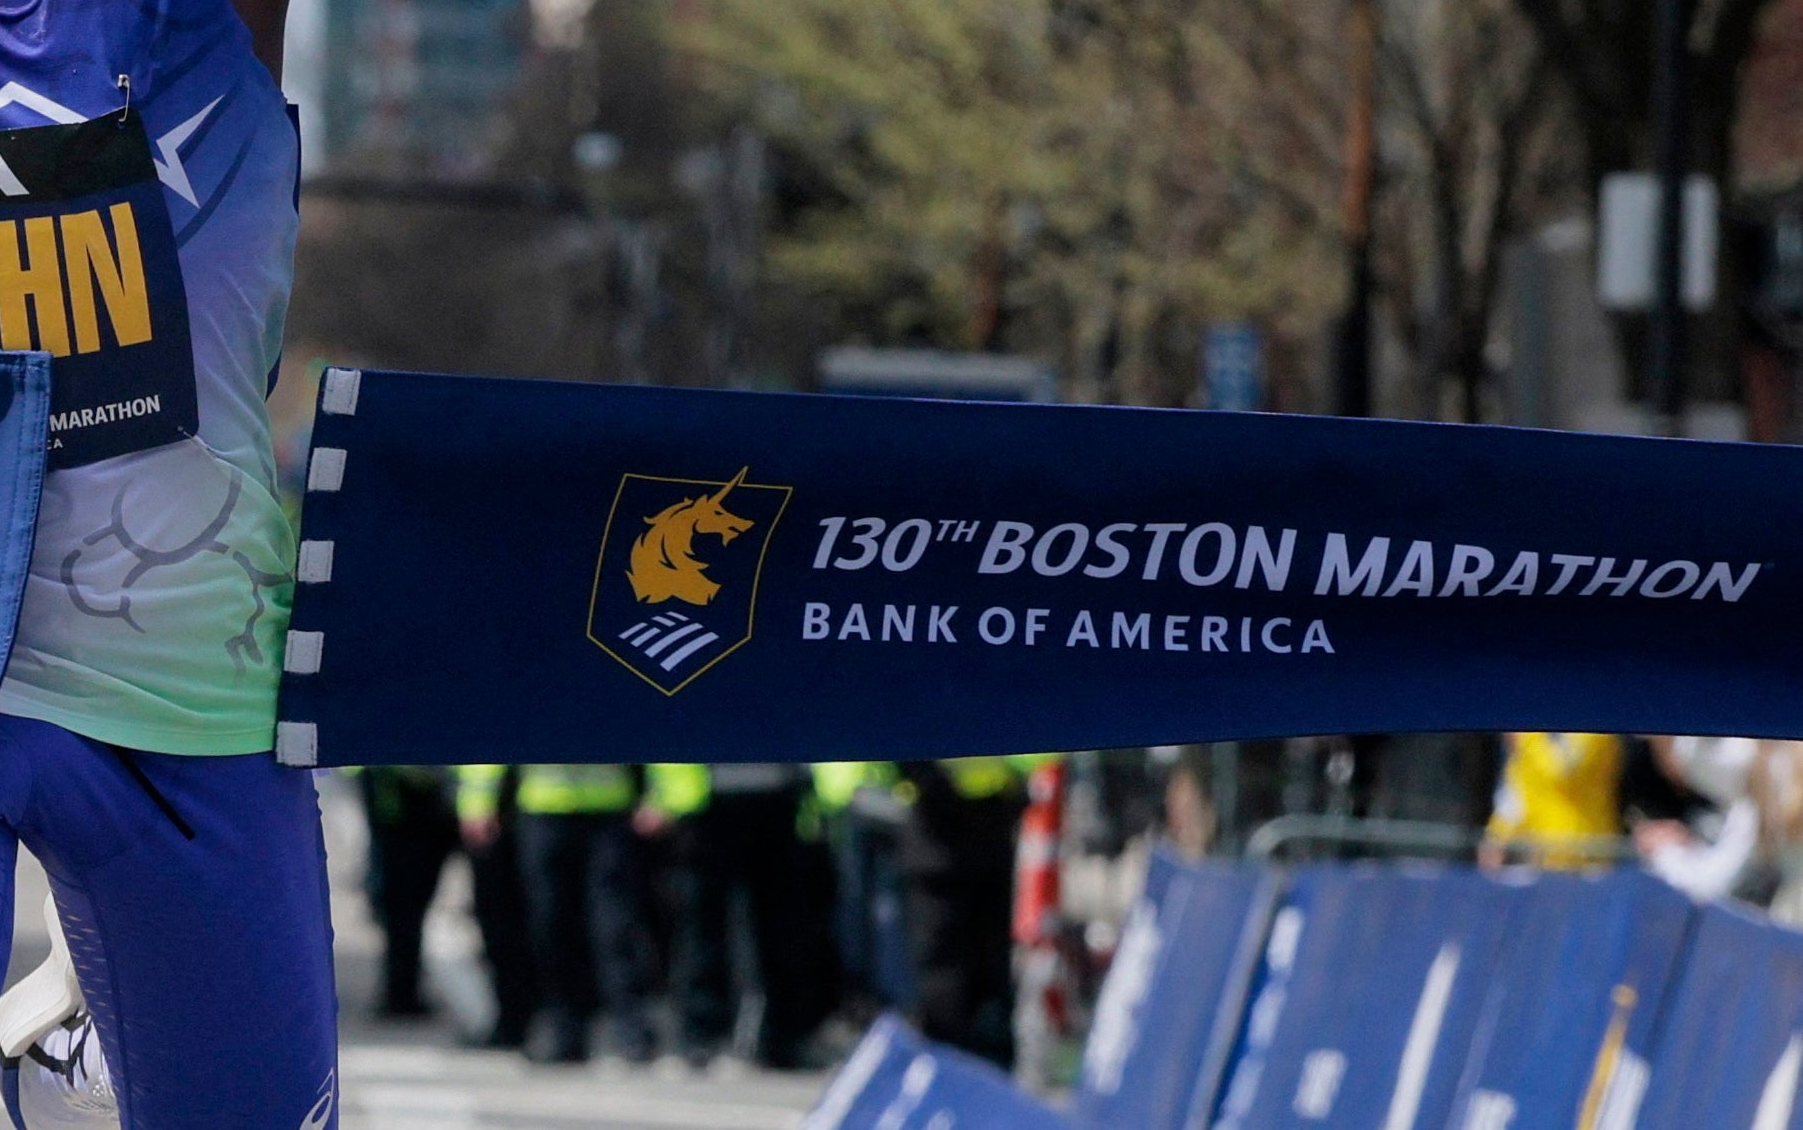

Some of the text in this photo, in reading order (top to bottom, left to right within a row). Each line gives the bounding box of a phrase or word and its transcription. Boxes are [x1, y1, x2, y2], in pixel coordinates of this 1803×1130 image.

[49, 394, 161, 432] MARATHON
[812, 516, 1762, 603] 130TH BOSTON MARATHON
[801, 601, 1336, 655] BANK OF AMERICA
